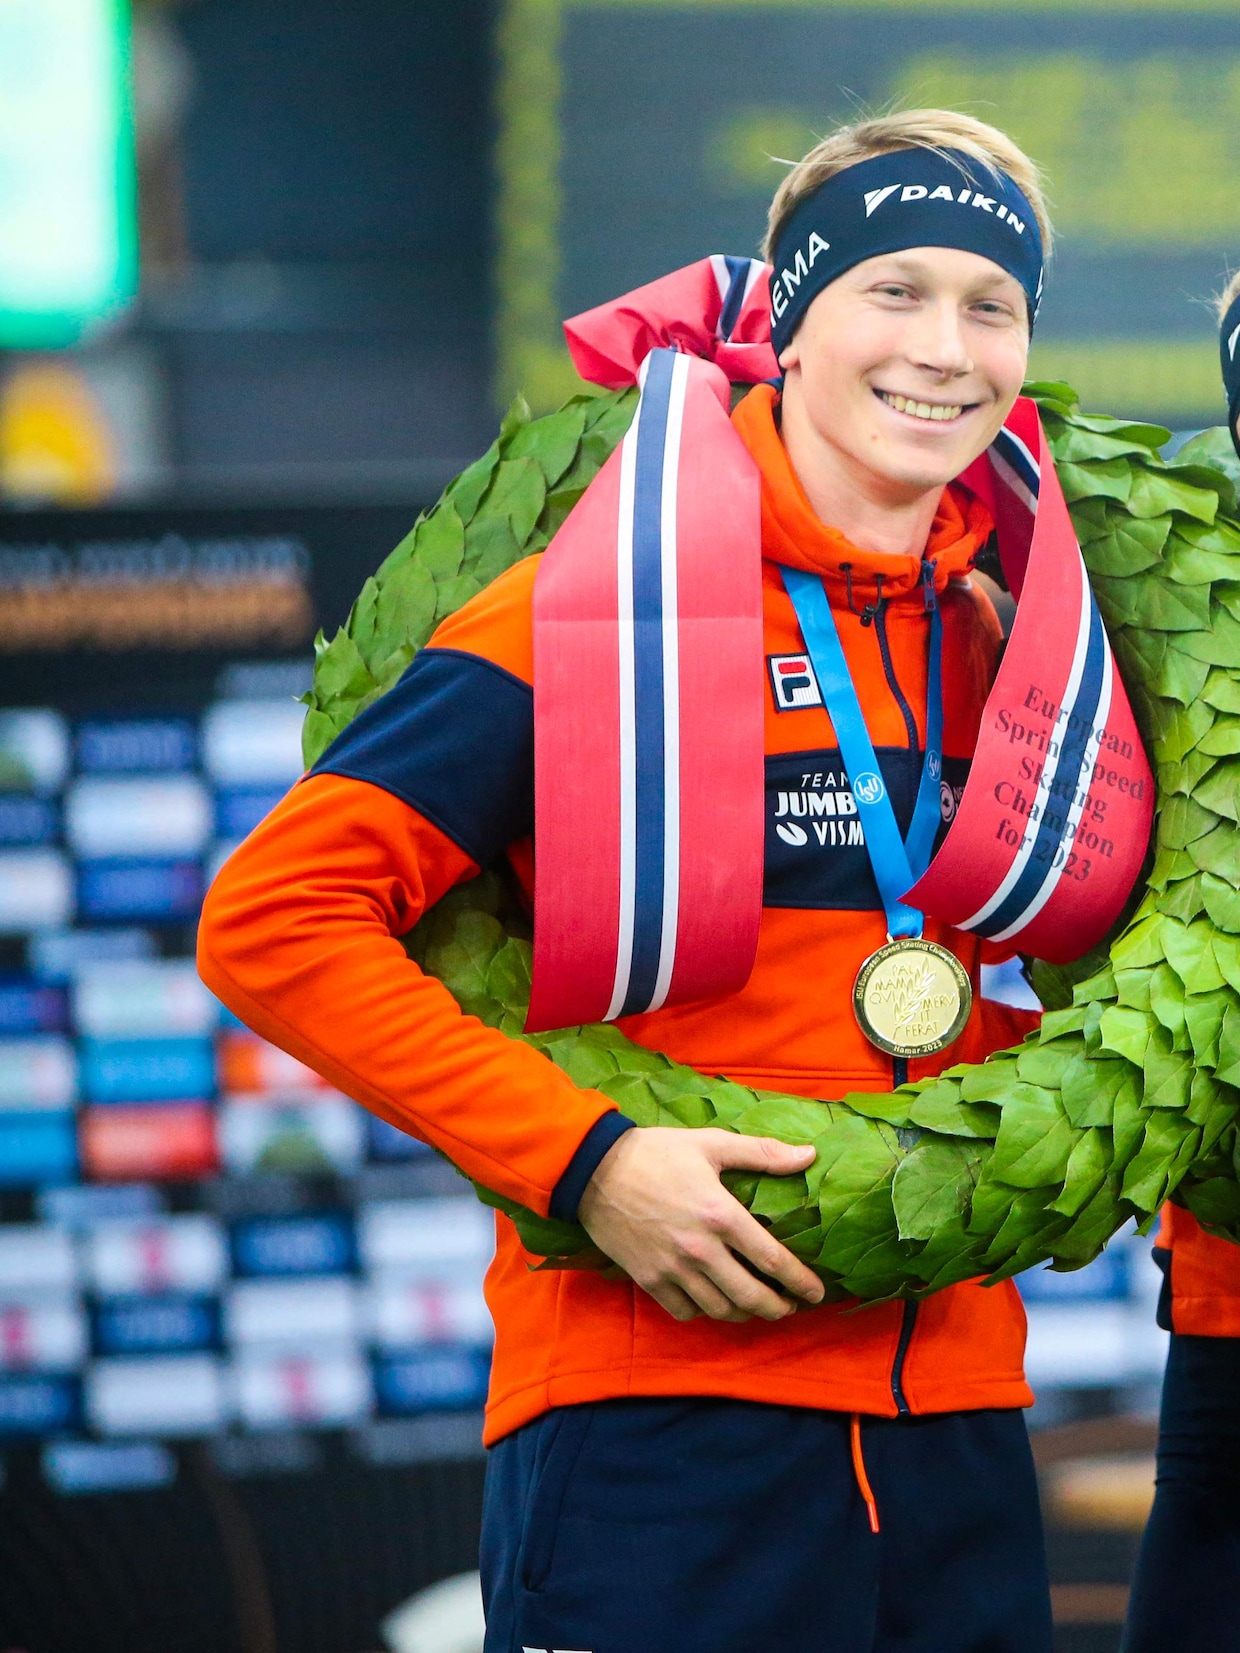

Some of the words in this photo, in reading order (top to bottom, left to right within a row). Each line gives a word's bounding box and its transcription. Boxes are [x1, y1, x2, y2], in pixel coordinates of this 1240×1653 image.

[900, 184, 1026, 235] DAIKIN
[1023, 684, 1134, 760] European
[1018, 756, 1109, 823] Skating
[1079, 750, 1145, 801] Speed
[775, 791, 859, 817] JUMB
[993, 781, 1115, 858] Champion
[812, 821, 865, 846] VISM
[995, 818, 1033, 852] for
[1035, 839, 1092, 881] 2023
[893, 1045, 921, 1055] Hamar
[923, 1040, 943, 1053] 2023
